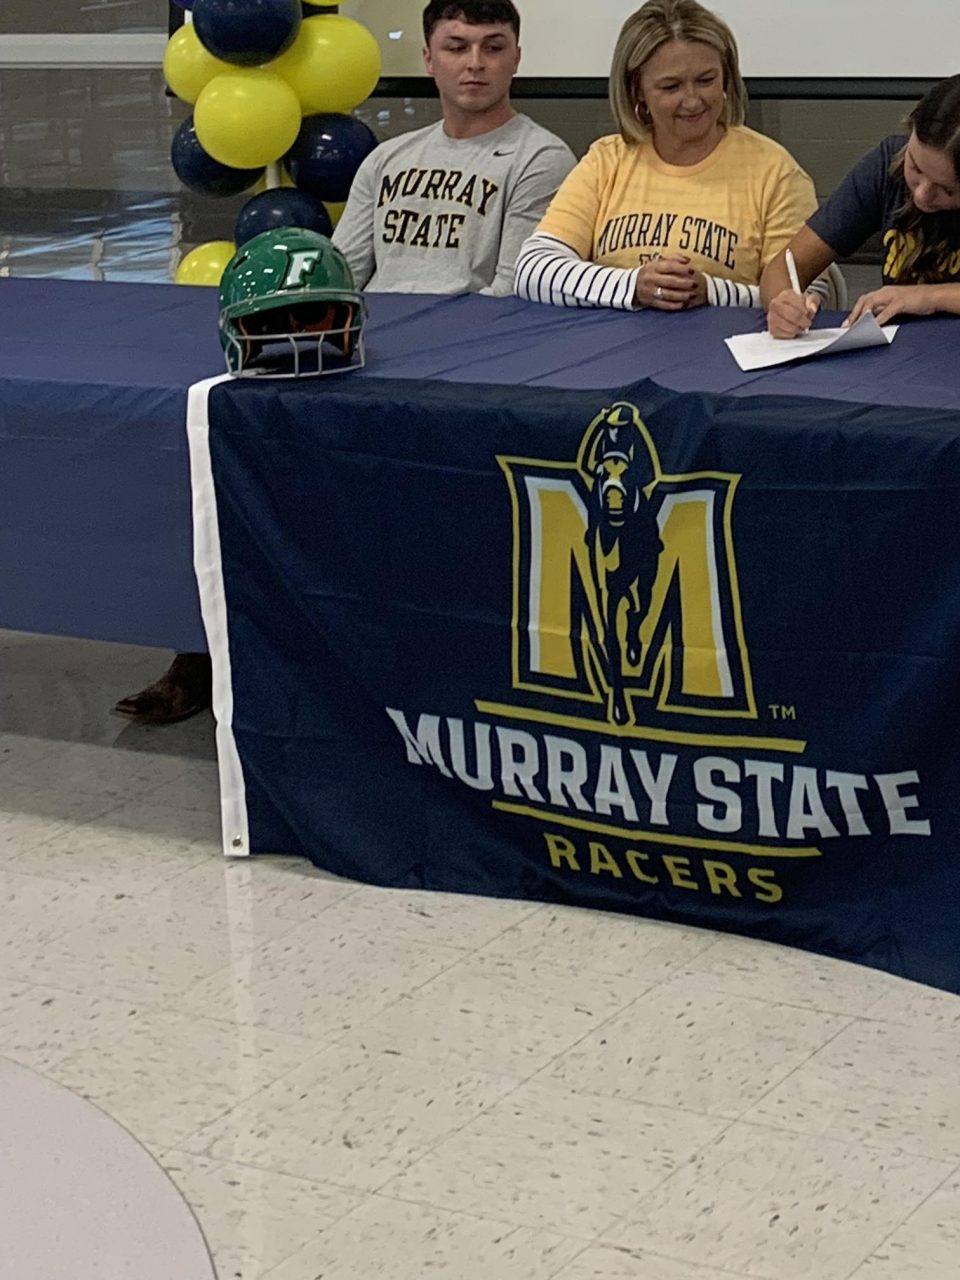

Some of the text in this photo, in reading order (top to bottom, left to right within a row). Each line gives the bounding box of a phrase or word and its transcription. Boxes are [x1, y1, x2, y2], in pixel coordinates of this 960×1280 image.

[377, 167, 498, 216] MURRAY
[382, 209, 466, 249] STATE
[595, 212, 739, 270] MURRAY STATE
[279, 247, 323, 289] F
[769, 705, 797, 720] TM
[385, 706, 931, 841] MURRAY STATE
[544, 832, 784, 903] RACERS
